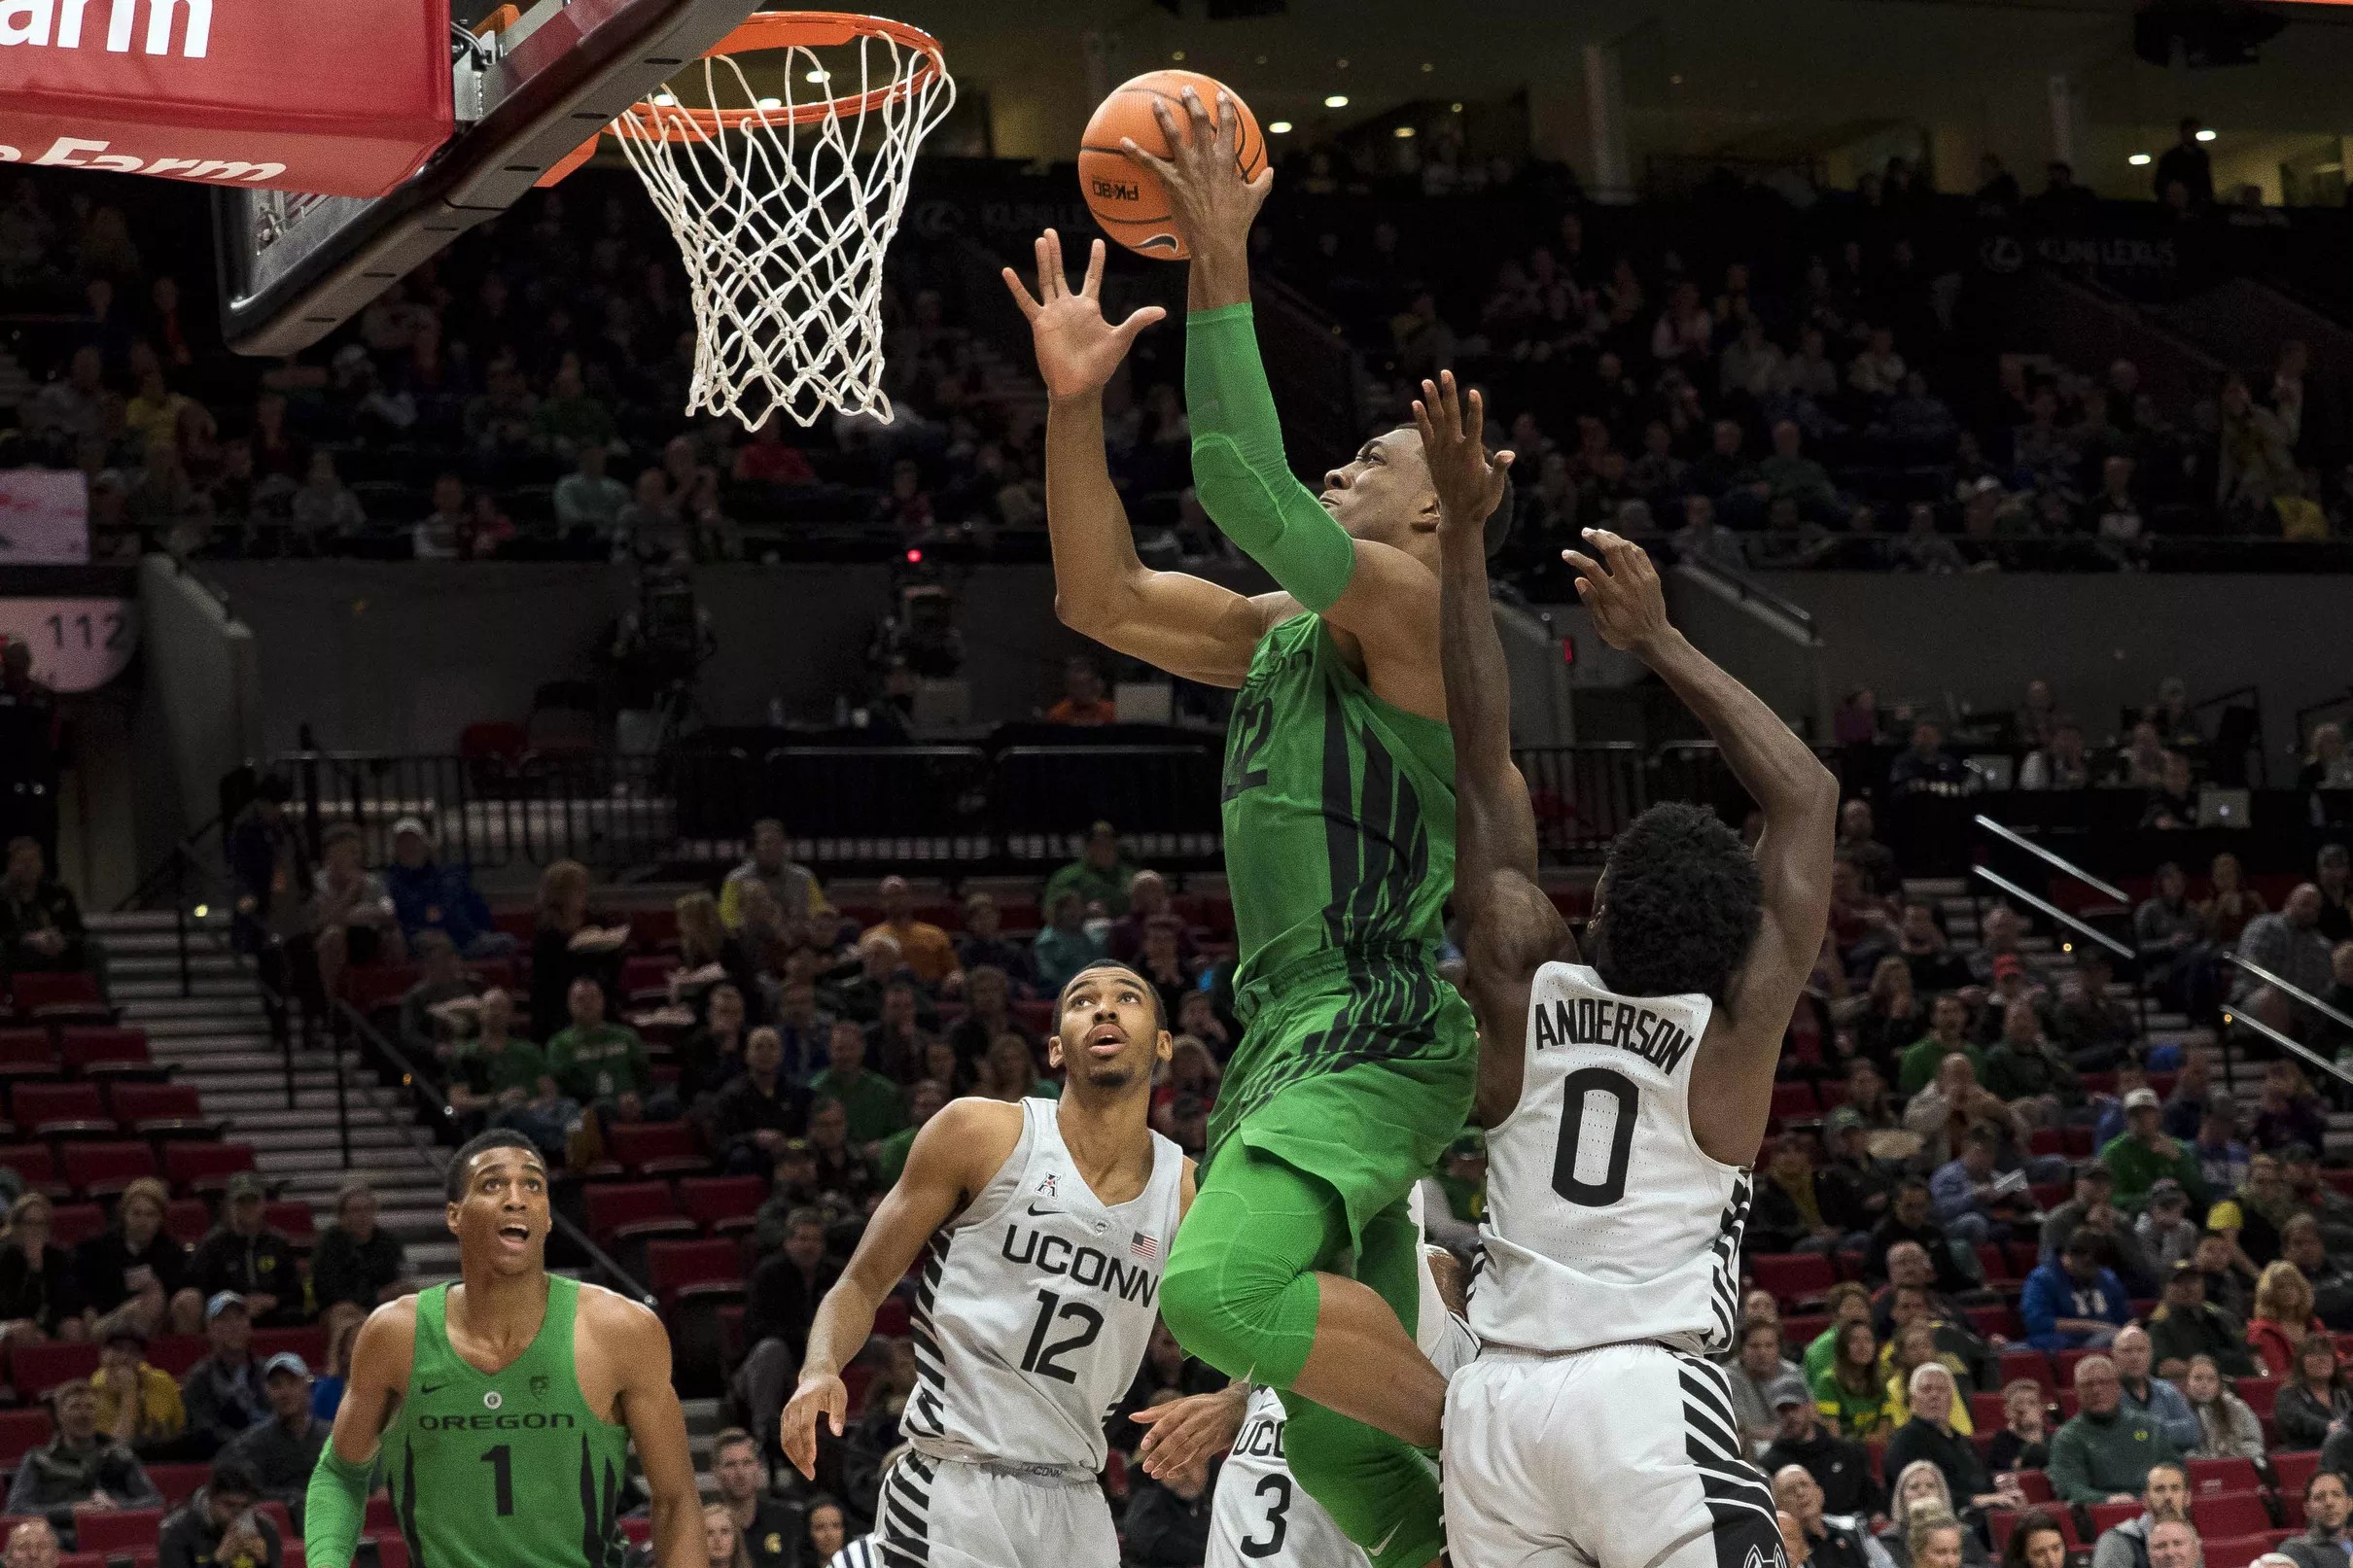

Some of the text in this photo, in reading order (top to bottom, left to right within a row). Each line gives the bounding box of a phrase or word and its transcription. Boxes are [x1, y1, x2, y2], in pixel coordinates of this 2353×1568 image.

[47, 612, 127, 649] 112
[1535, 998, 1694, 1075] ANDERSON
[1552, 1067, 1639, 1207] 0
[1001, 1224, 1159, 1308] UCONN
[1020, 1288, 1105, 1384] 12
[419, 1413, 575, 1430] OREGON
[480, 1445, 514, 1516] 1
[1241, 1473, 1291, 1558] 3
